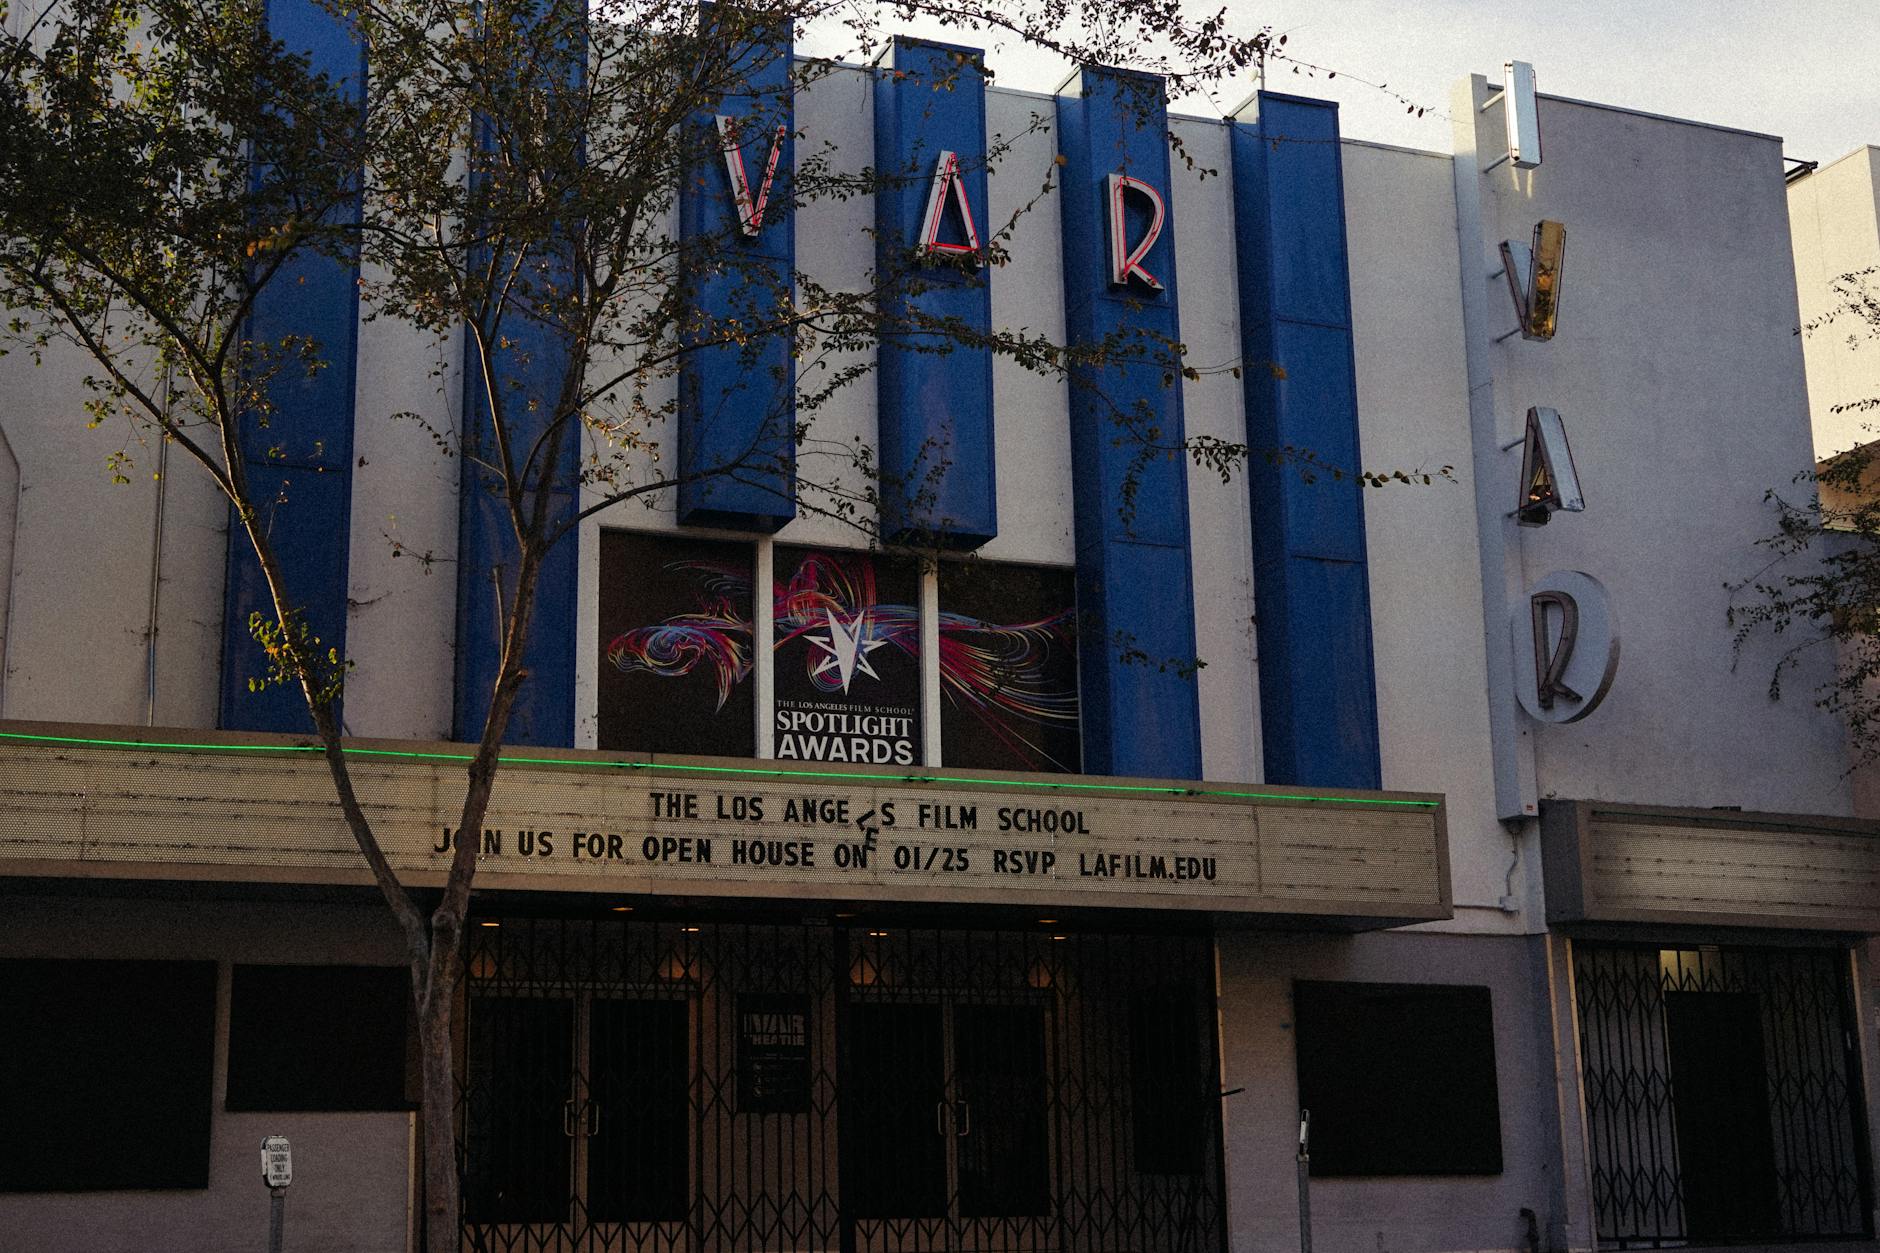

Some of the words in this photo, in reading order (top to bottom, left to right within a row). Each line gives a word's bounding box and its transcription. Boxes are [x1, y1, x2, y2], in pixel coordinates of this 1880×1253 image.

[777, 700, 795, 708] THE
[799, 701, 813, 709] LOS
[814, 702, 848, 711] ANGELES
[850, 705, 872, 713] FILM
[875, 706, 912, 715] SCHOOL
[777, 710, 913, 737] SPOTLIGHT
[777, 734, 914, 765] AWARDS
[650, 792, 698, 819] THE
[717, 795, 764, 822] LOS
[919, 804, 977, 830] FILM
[999, 807, 1090, 834] SCHOOL
[518, 831, 554, 857] US
[573, 833, 623, 859] FOR
[642, 836, 711, 863] OPEN
[732, 840, 814, 867] HOUSE
[834, 843, 867, 869] ON
[993, 849, 1056, 875] RSVP
[1079, 853, 1217, 881] LAFILM.EDU
